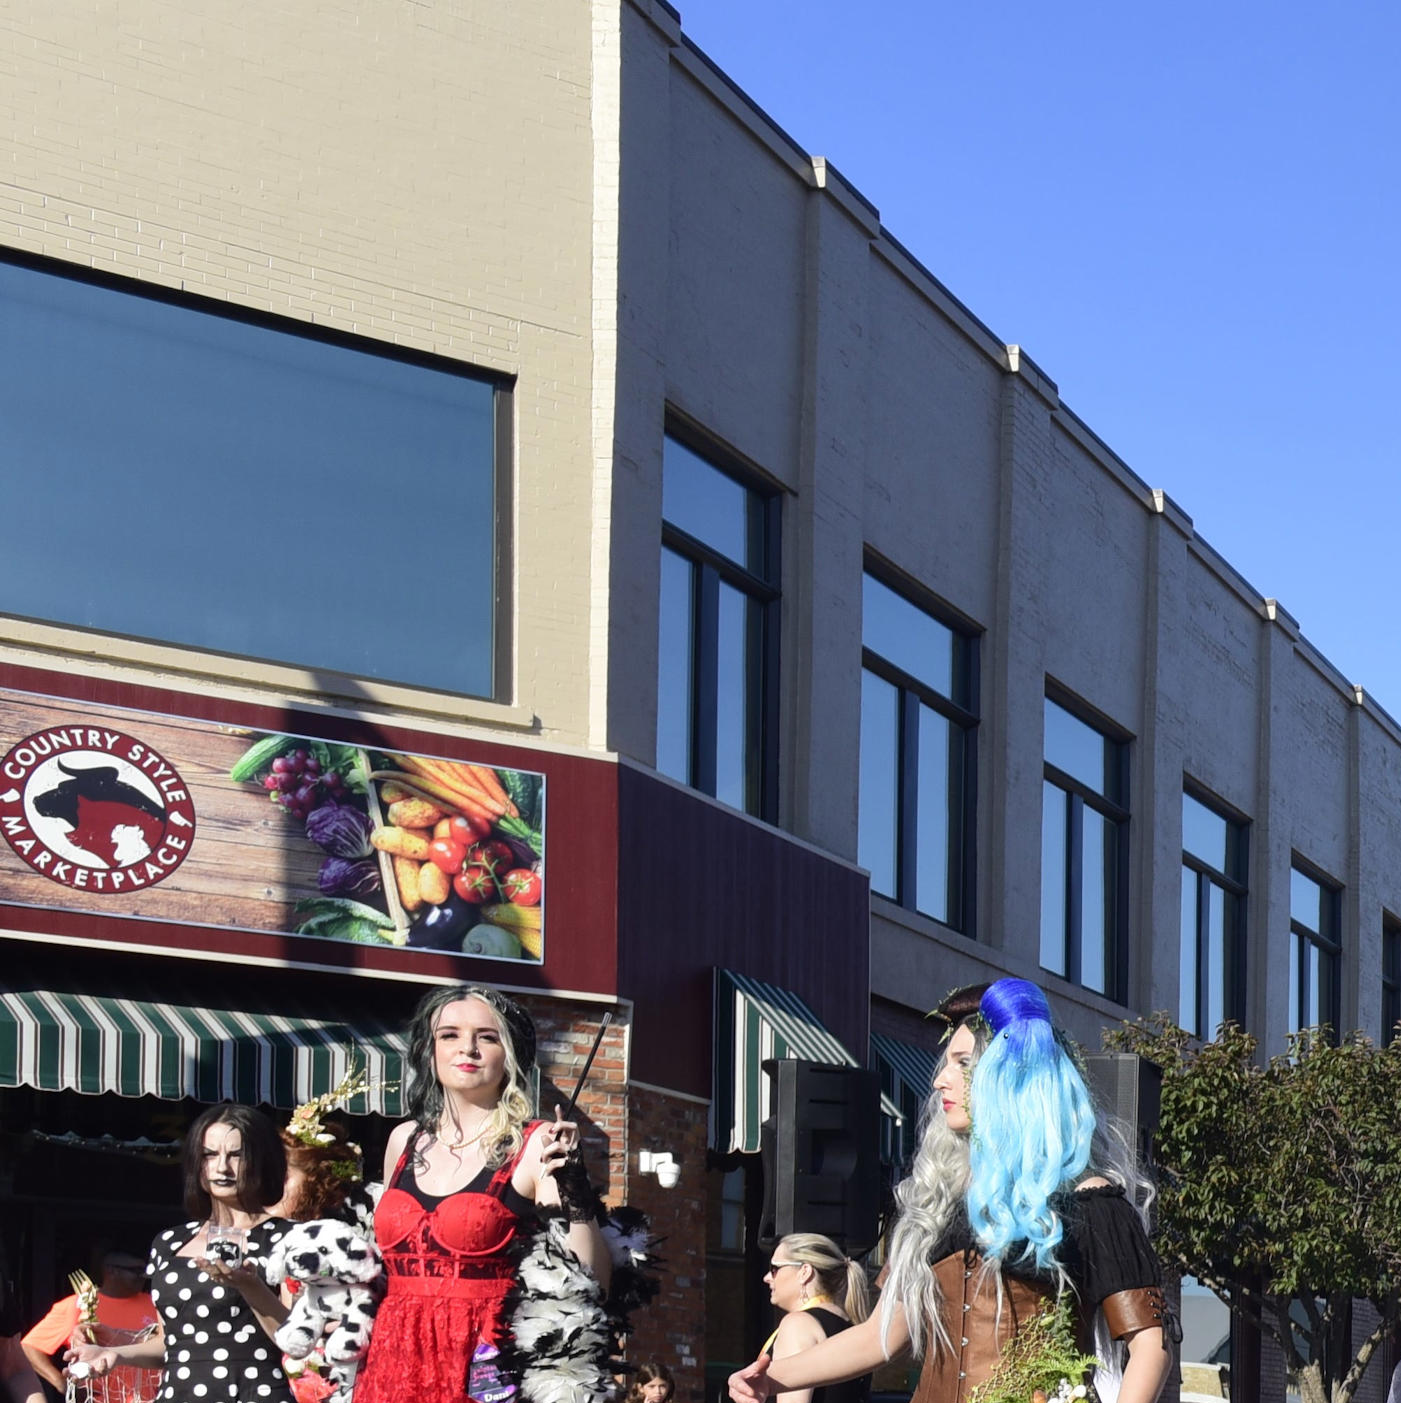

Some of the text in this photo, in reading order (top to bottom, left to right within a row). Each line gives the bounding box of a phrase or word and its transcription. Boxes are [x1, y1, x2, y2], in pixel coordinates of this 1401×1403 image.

[4, 729, 187, 802] COUNTRY STYLE
[1, 816, 187, 889] MARKETPLACE
